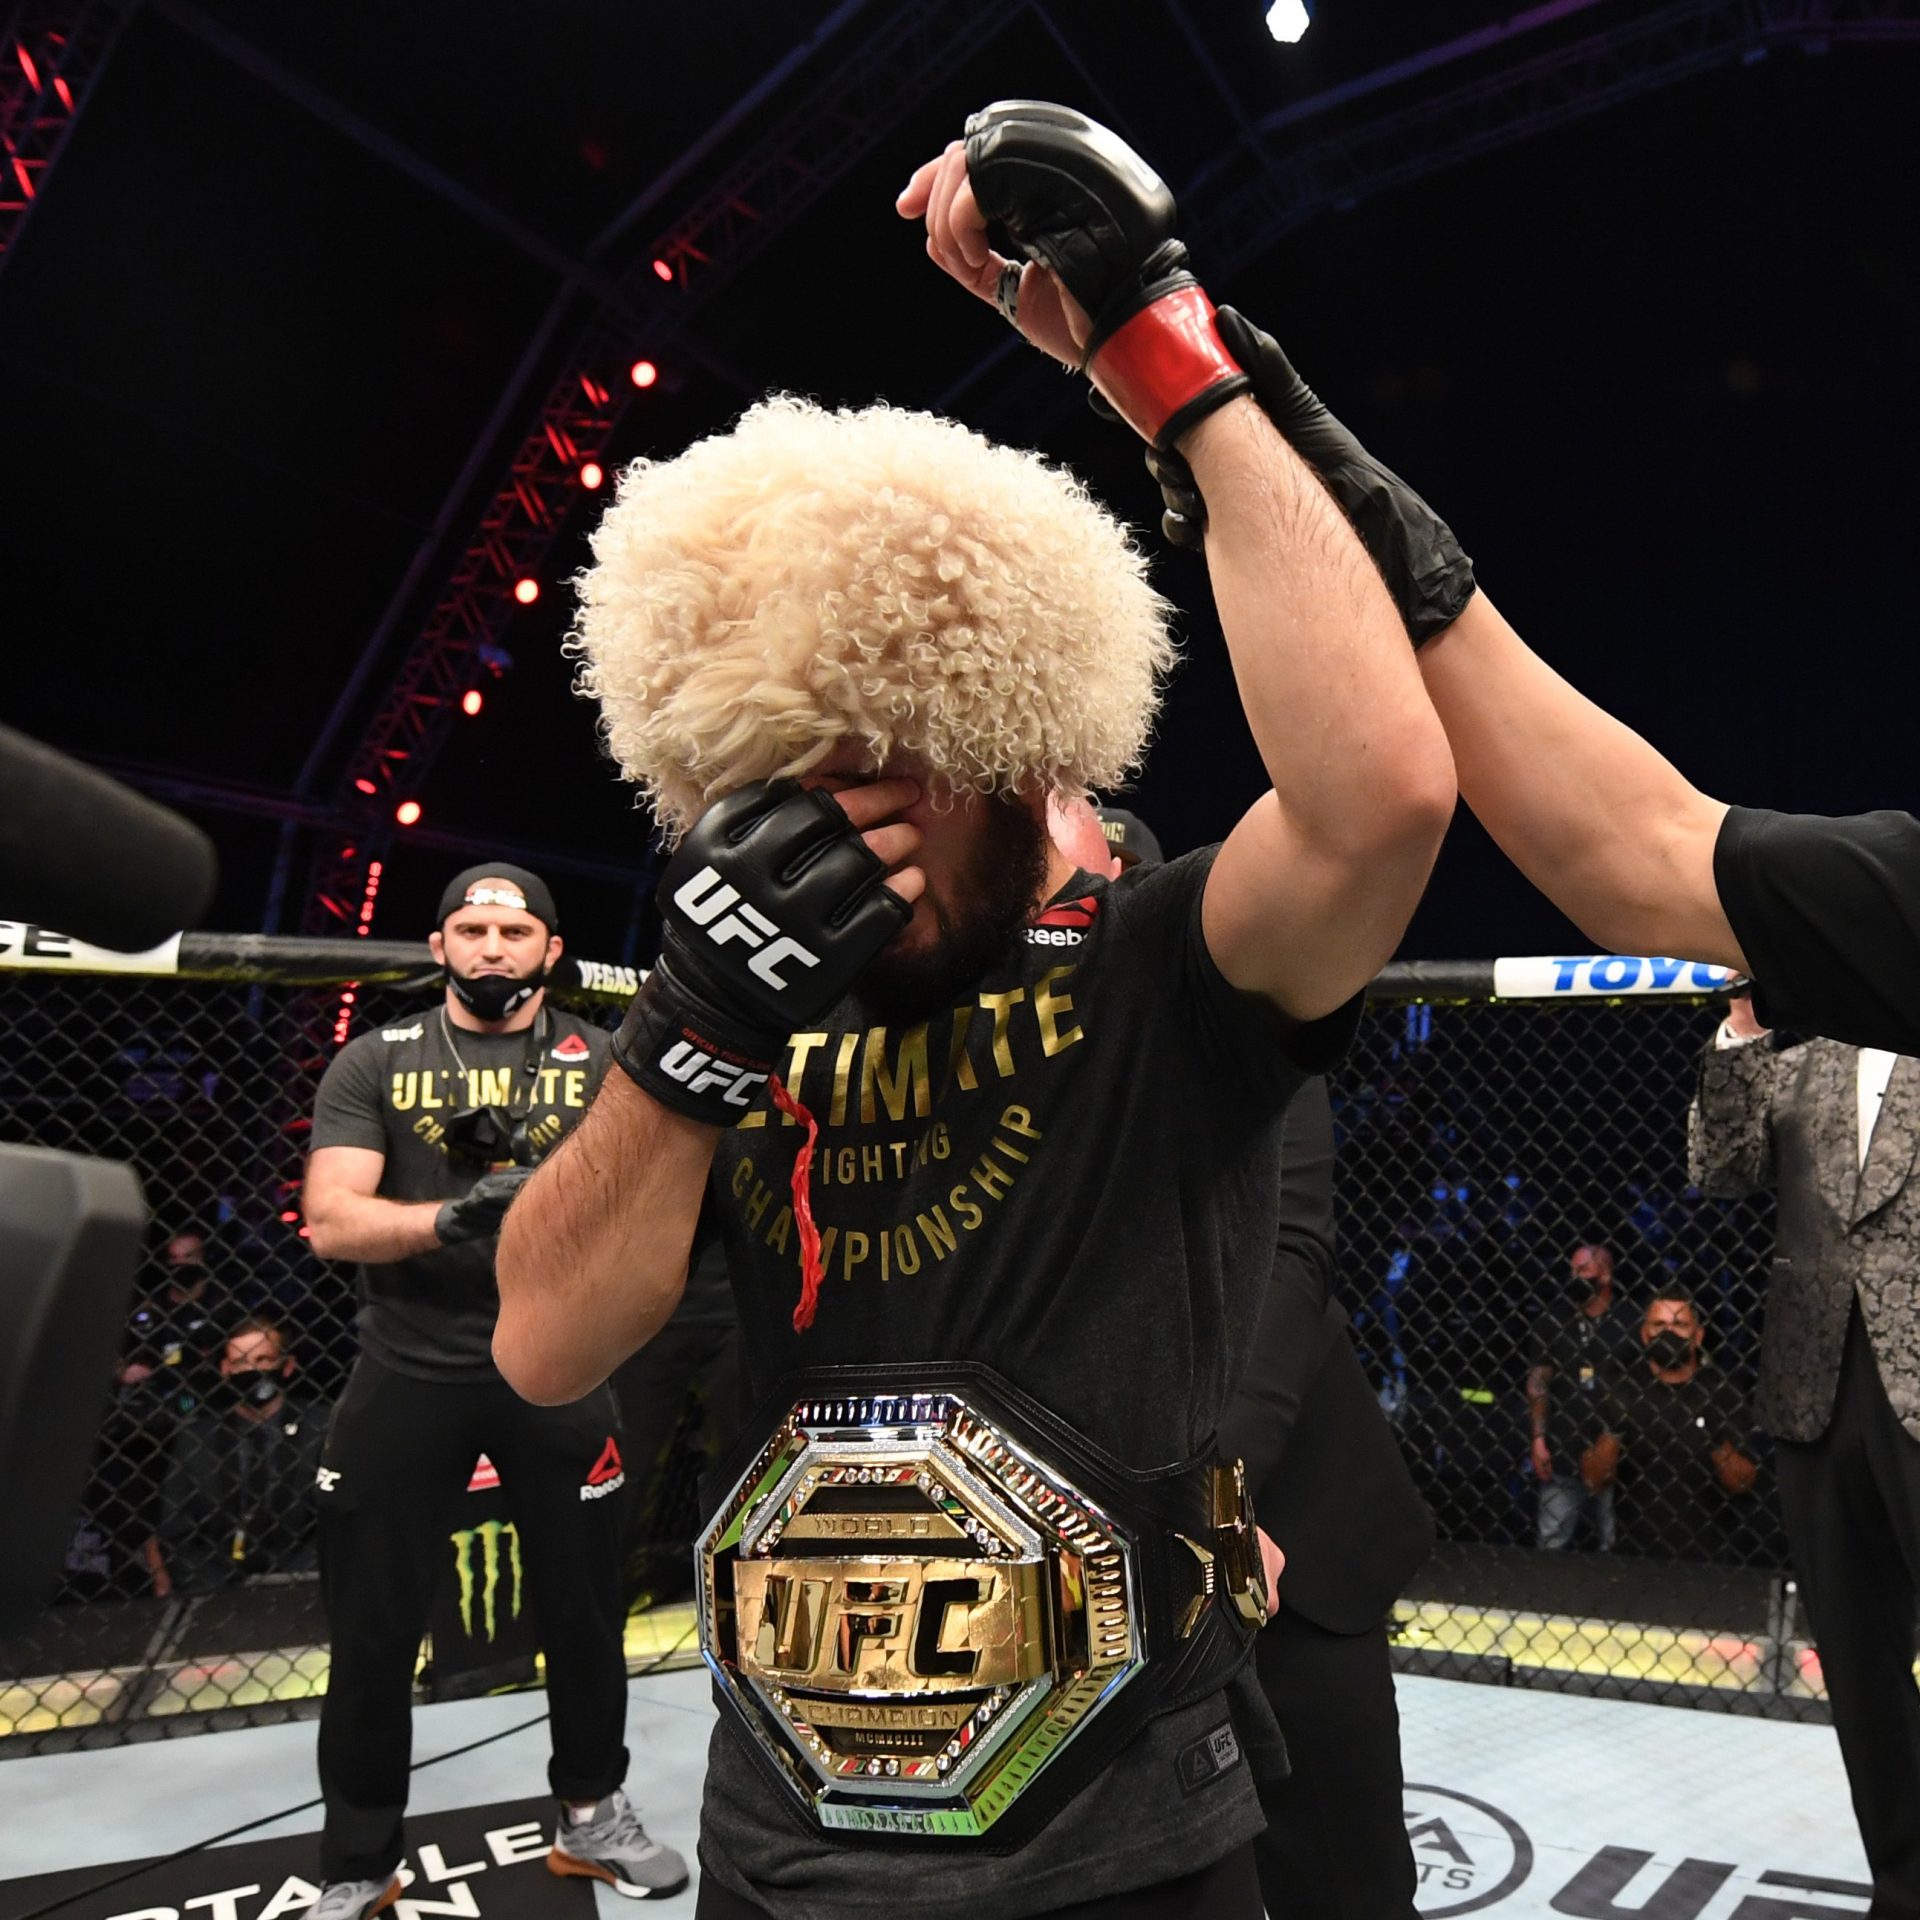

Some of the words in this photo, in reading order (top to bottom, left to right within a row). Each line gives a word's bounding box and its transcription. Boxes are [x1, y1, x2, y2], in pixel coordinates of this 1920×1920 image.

[673, 865, 822, 992] UFC
[1022, 927, 1088, 947] Reeb
[576, 959, 639, 996] VEGAS
[381, 1022, 424, 1042] UFC
[737, 963, 1085, 1130] TIMTE
[392, 1067, 586, 1111] ULIMTE
[659, 1039, 769, 1107] UFC
[808, 1121, 951, 1186] IGHTING
[315, 1466, 342, 1492] FC
[814, 1516, 931, 1536] WORLD
[754, 1573, 998, 1677] UFC
[807, 1704, 959, 1726] CHAMPION
[1214, 1730, 1232, 1754] UFC
[1549, 1844, 1874, 1920] UF
